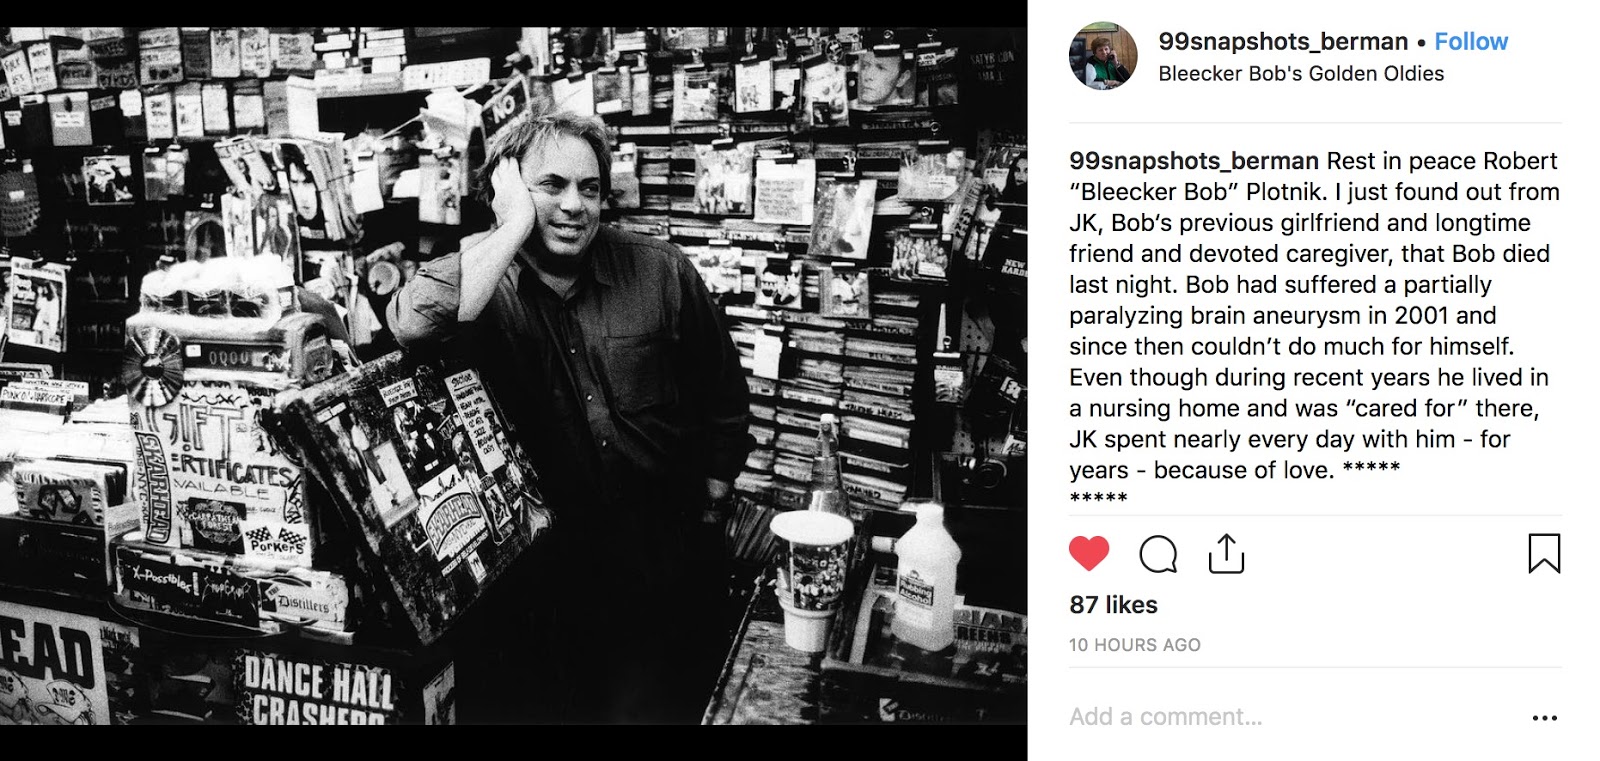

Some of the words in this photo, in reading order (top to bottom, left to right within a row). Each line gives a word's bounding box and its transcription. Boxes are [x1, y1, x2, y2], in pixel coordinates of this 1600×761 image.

[492, 95, 516, 124] NO
[171, 453, 292, 488] RTIFICATES
[138, 433, 170, 542] SKARHEAD
[427, 493, 480, 547] SKARHEAD
[132, 564, 193, 594] X-Possibles
[900, 579, 932, 598] Rubbing
[278, 594, 330, 614] Distillers
[900, 588, 932, 605] Alcohol
[245, 655, 324, 699] DANCE
[333, 666, 394, 711] HALL
